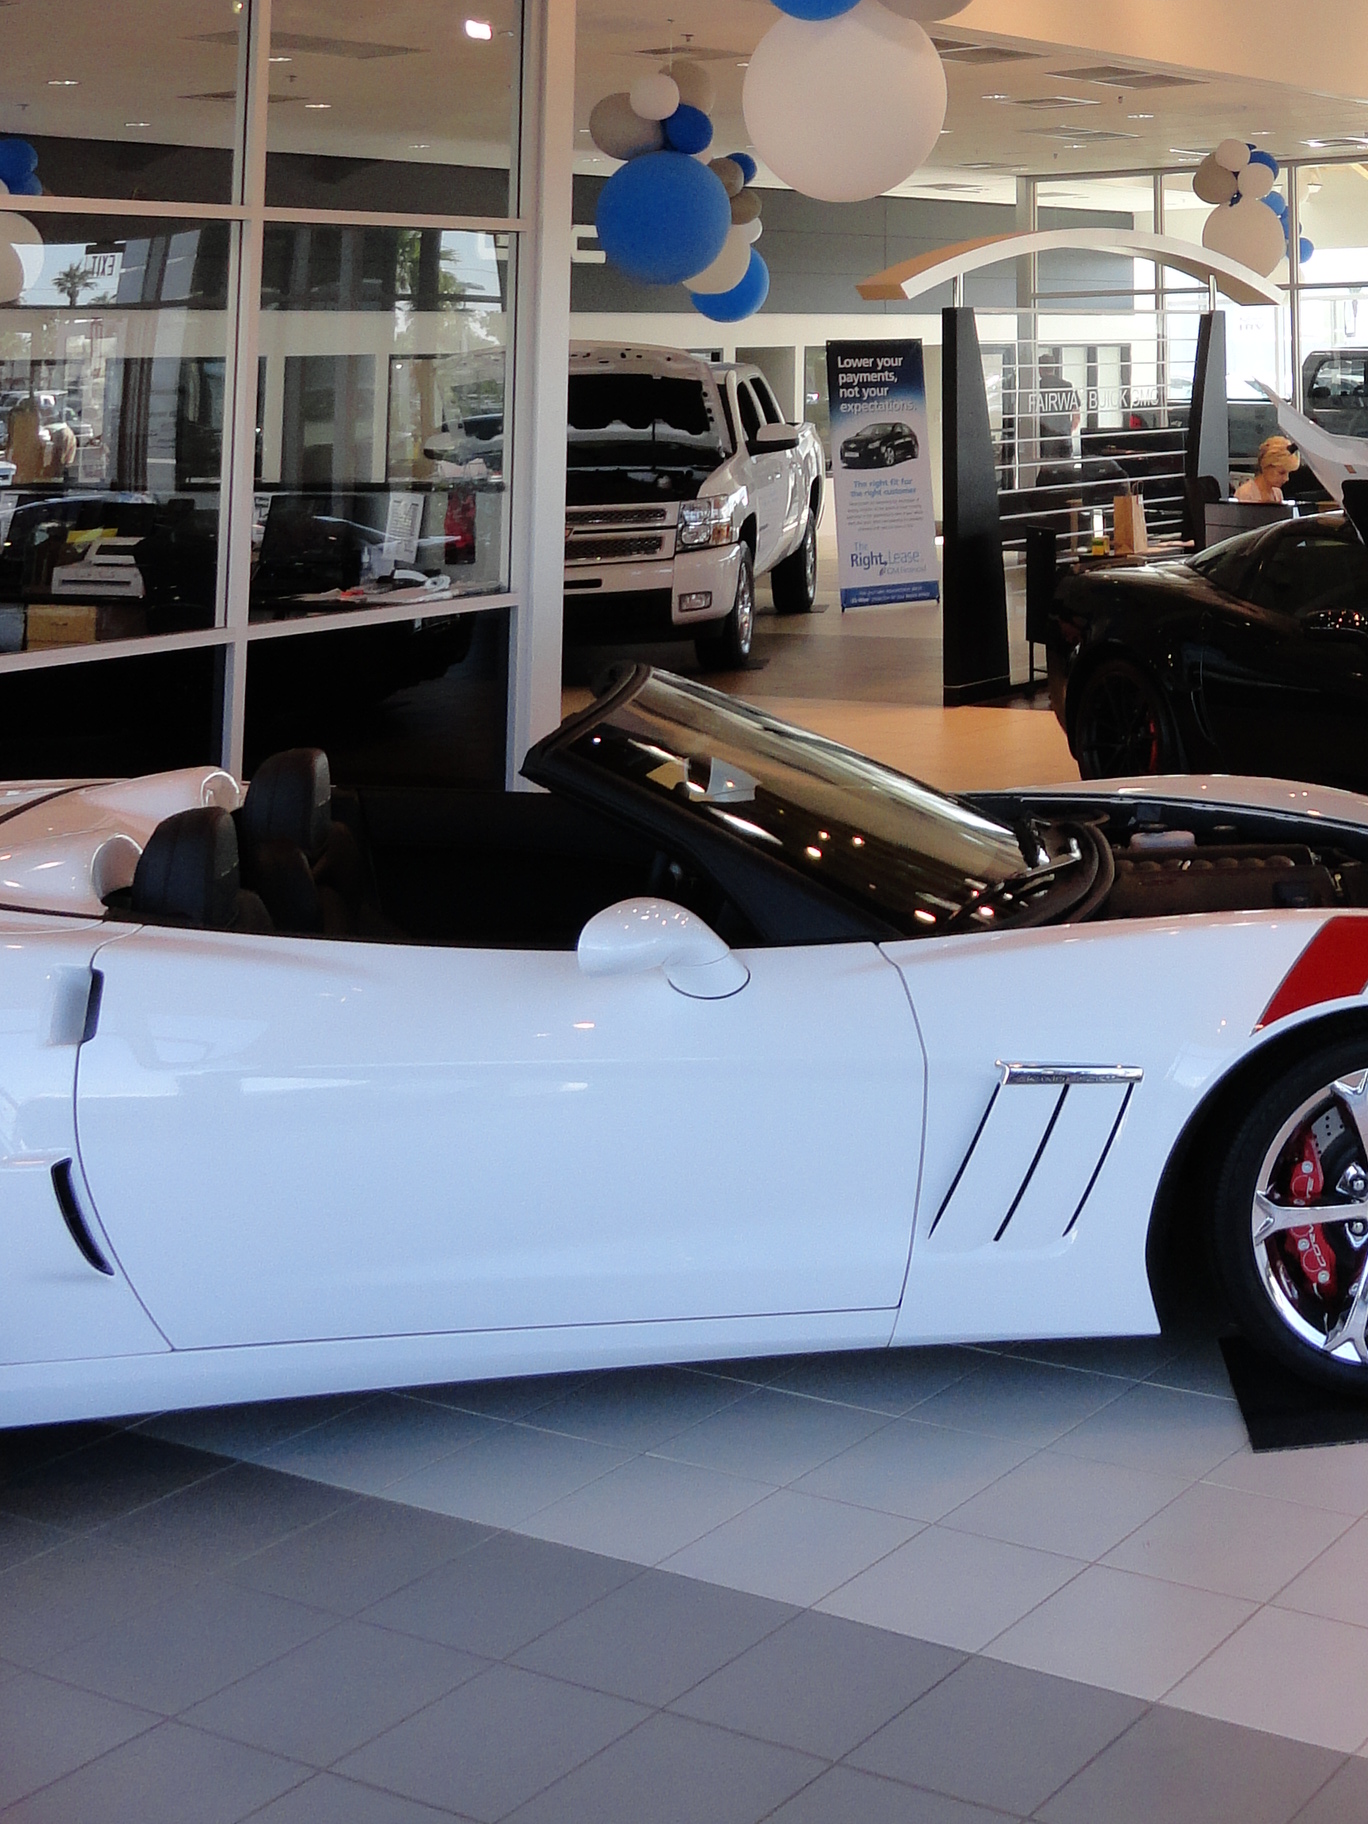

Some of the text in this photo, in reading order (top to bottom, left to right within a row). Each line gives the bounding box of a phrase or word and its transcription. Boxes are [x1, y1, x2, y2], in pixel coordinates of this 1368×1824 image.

[837, 356, 904, 370] Lower your
[838, 370, 898, 386] payments,
[839, 387, 890, 400] not your
[1028, 388, 1160, 413] FAIRWA BUICK GMC
[840, 399, 918, 415] expectations.
[853, 477, 913, 489] The right fit for
[864, 489, 882, 498] right
[854, 542, 868, 552] The
[888, 550, 920, 565] Lease
